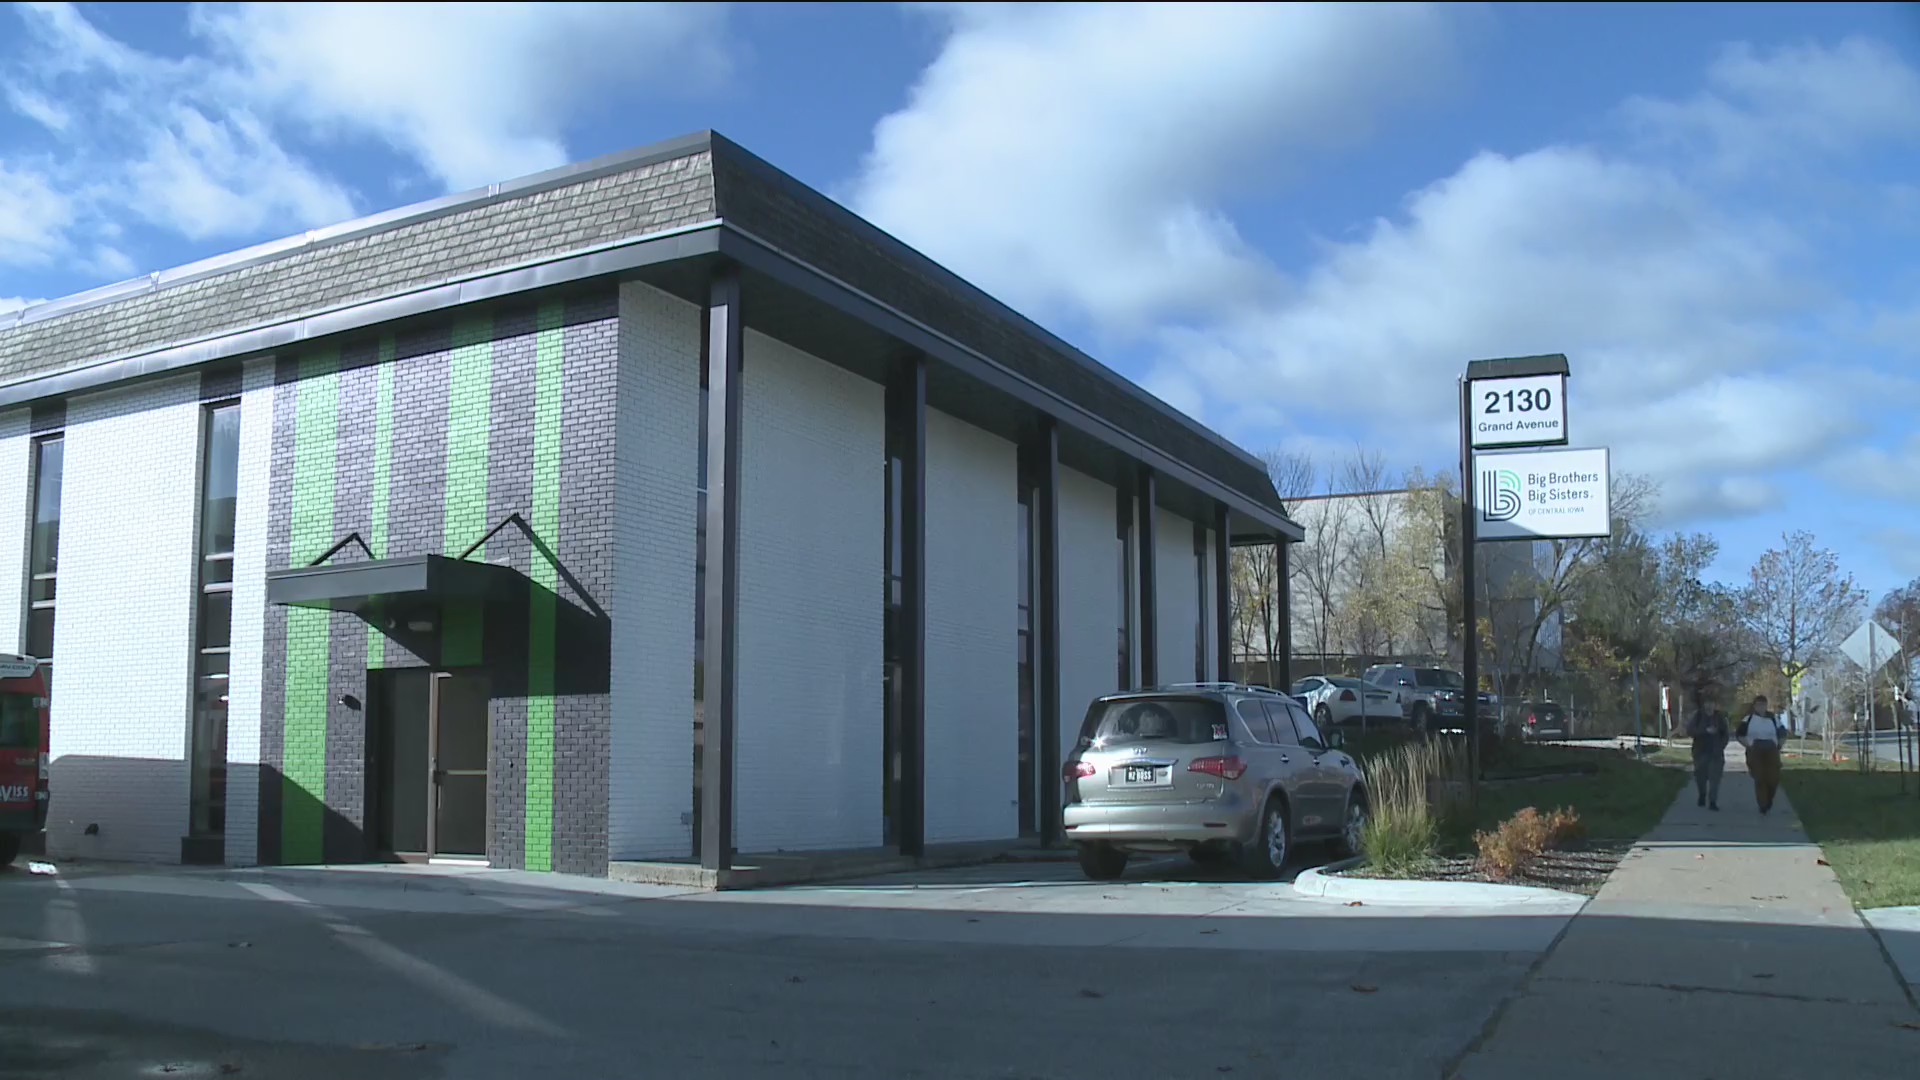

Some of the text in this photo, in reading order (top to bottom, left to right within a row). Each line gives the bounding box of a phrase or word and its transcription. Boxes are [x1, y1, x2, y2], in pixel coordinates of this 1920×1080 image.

[1485, 387, 1552, 414] 2130
[1478, 420, 1559, 432] Grand Avenue
[1528, 471, 1599, 488] Big Brothers
[1528, 489, 1546, 504] Big
[1537, 507, 1566, 515] CENTRAL
